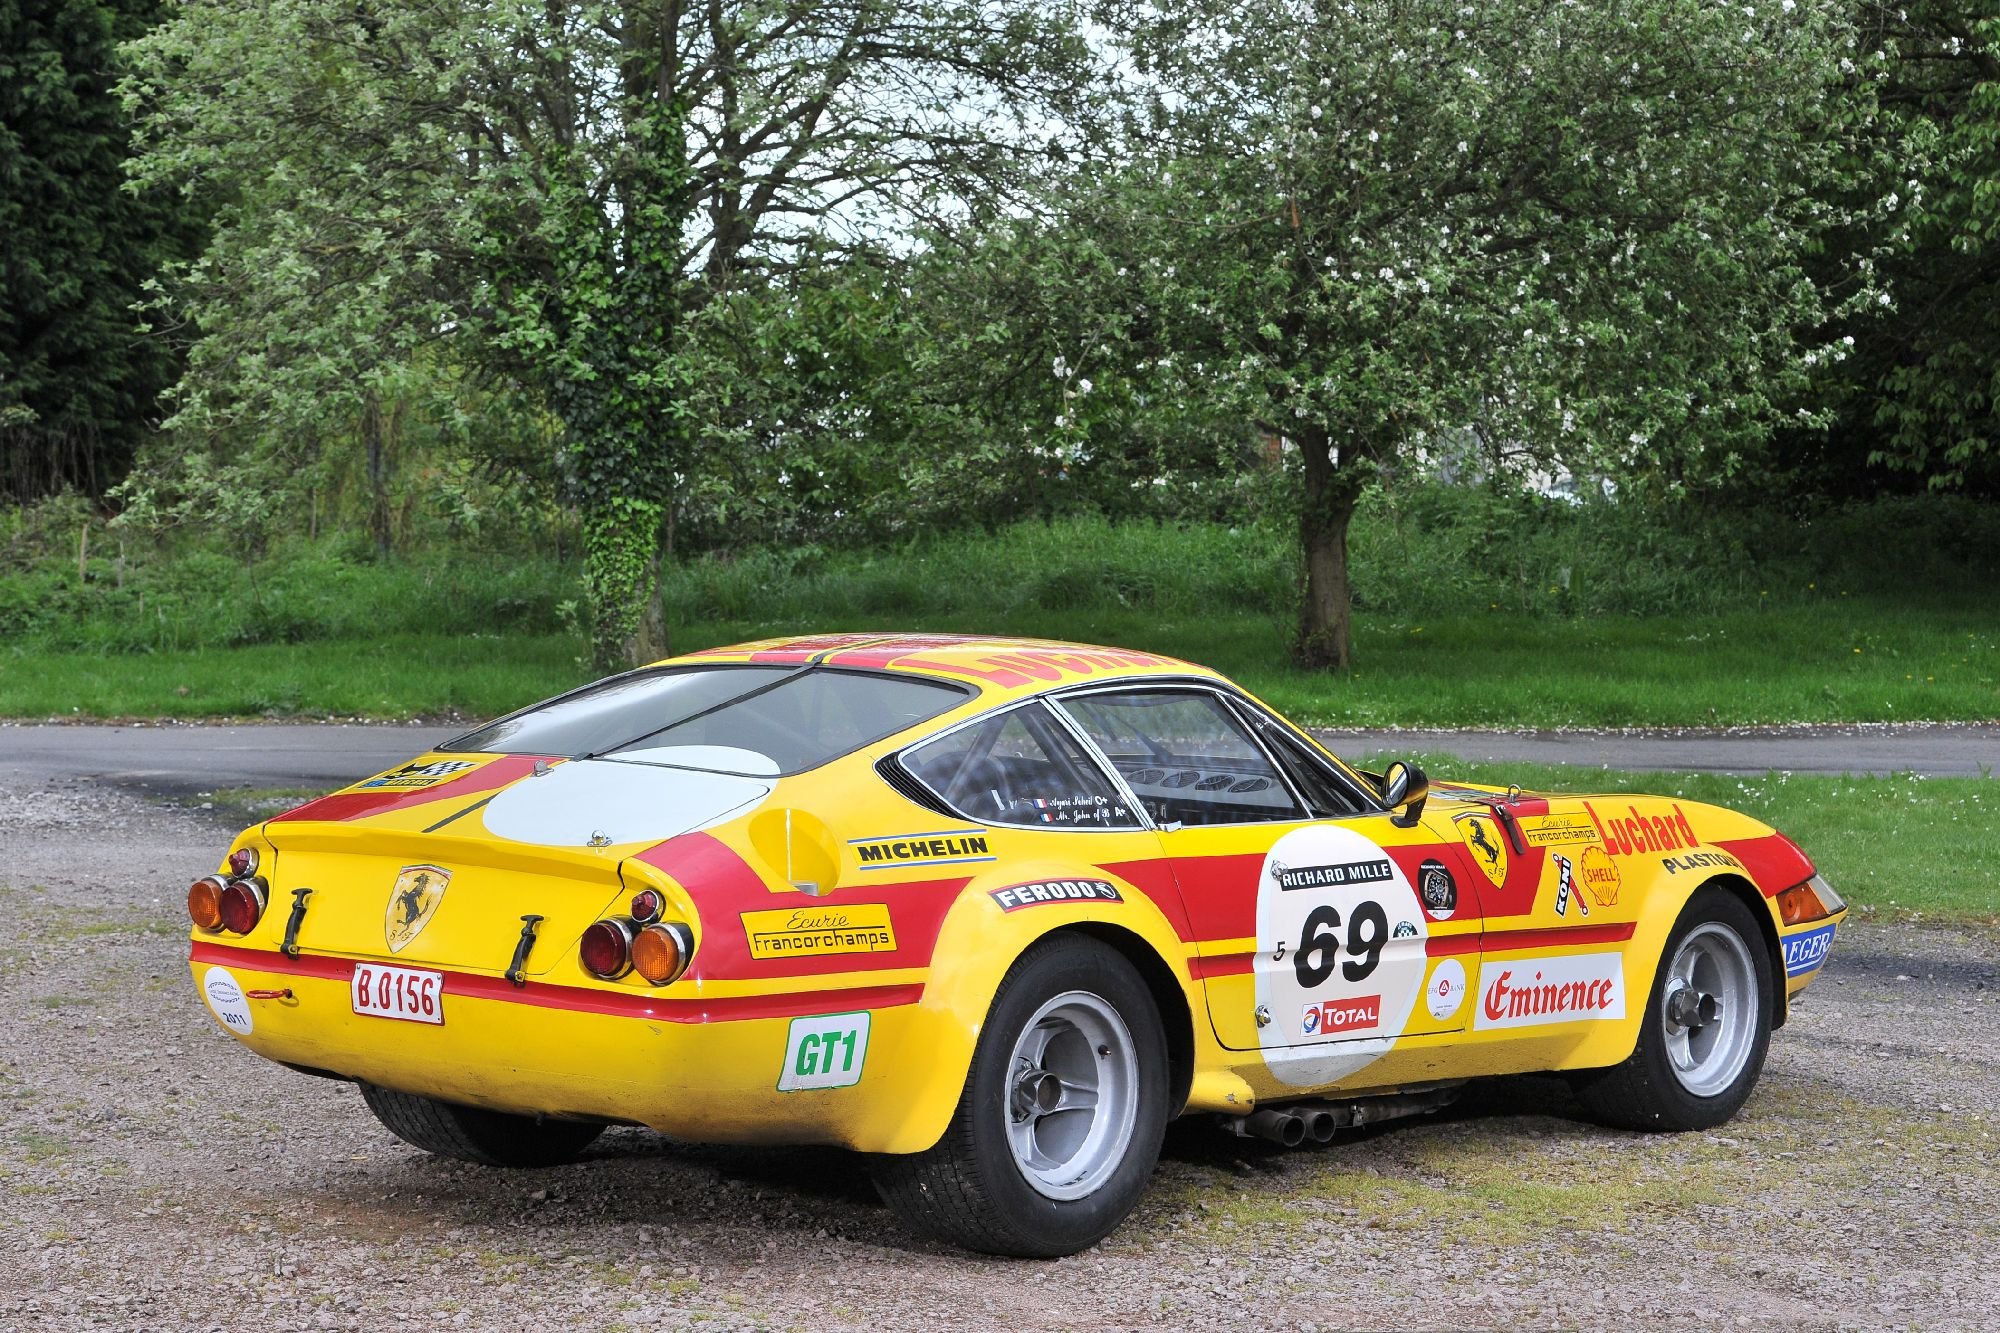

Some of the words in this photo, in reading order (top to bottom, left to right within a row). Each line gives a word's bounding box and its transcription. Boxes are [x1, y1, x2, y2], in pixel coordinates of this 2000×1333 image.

[1073, 810, 1090, 823] John
[1541, 816, 1573, 829] Ecurie
[1526, 829, 1596, 843] Francorchamps
[1582, 801, 1700, 856] Luchard
[857, 837, 989, 862] MICHELIN
[1283, 867, 1345, 887] RICHARD
[1349, 863, 1391, 881] MILLE
[1557, 857, 1572, 916] KONI
[1586, 867, 1617, 884] SHELL
[998, 881, 1098, 908] FERODO
[786, 911, 850, 930] Ecurie
[752, 929, 890, 951] Francorchamps
[1273, 940, 1286, 962] 5
[1293, 900, 1389, 989] 69
[358, 969, 434, 1016] B.0156
[1484, 970, 1615, 1021] Eminence
[222, 1012, 248, 1026] 2011
[1324, 1006, 1378, 1026] TOTAL
[795, 1029, 857, 1076] GT1
